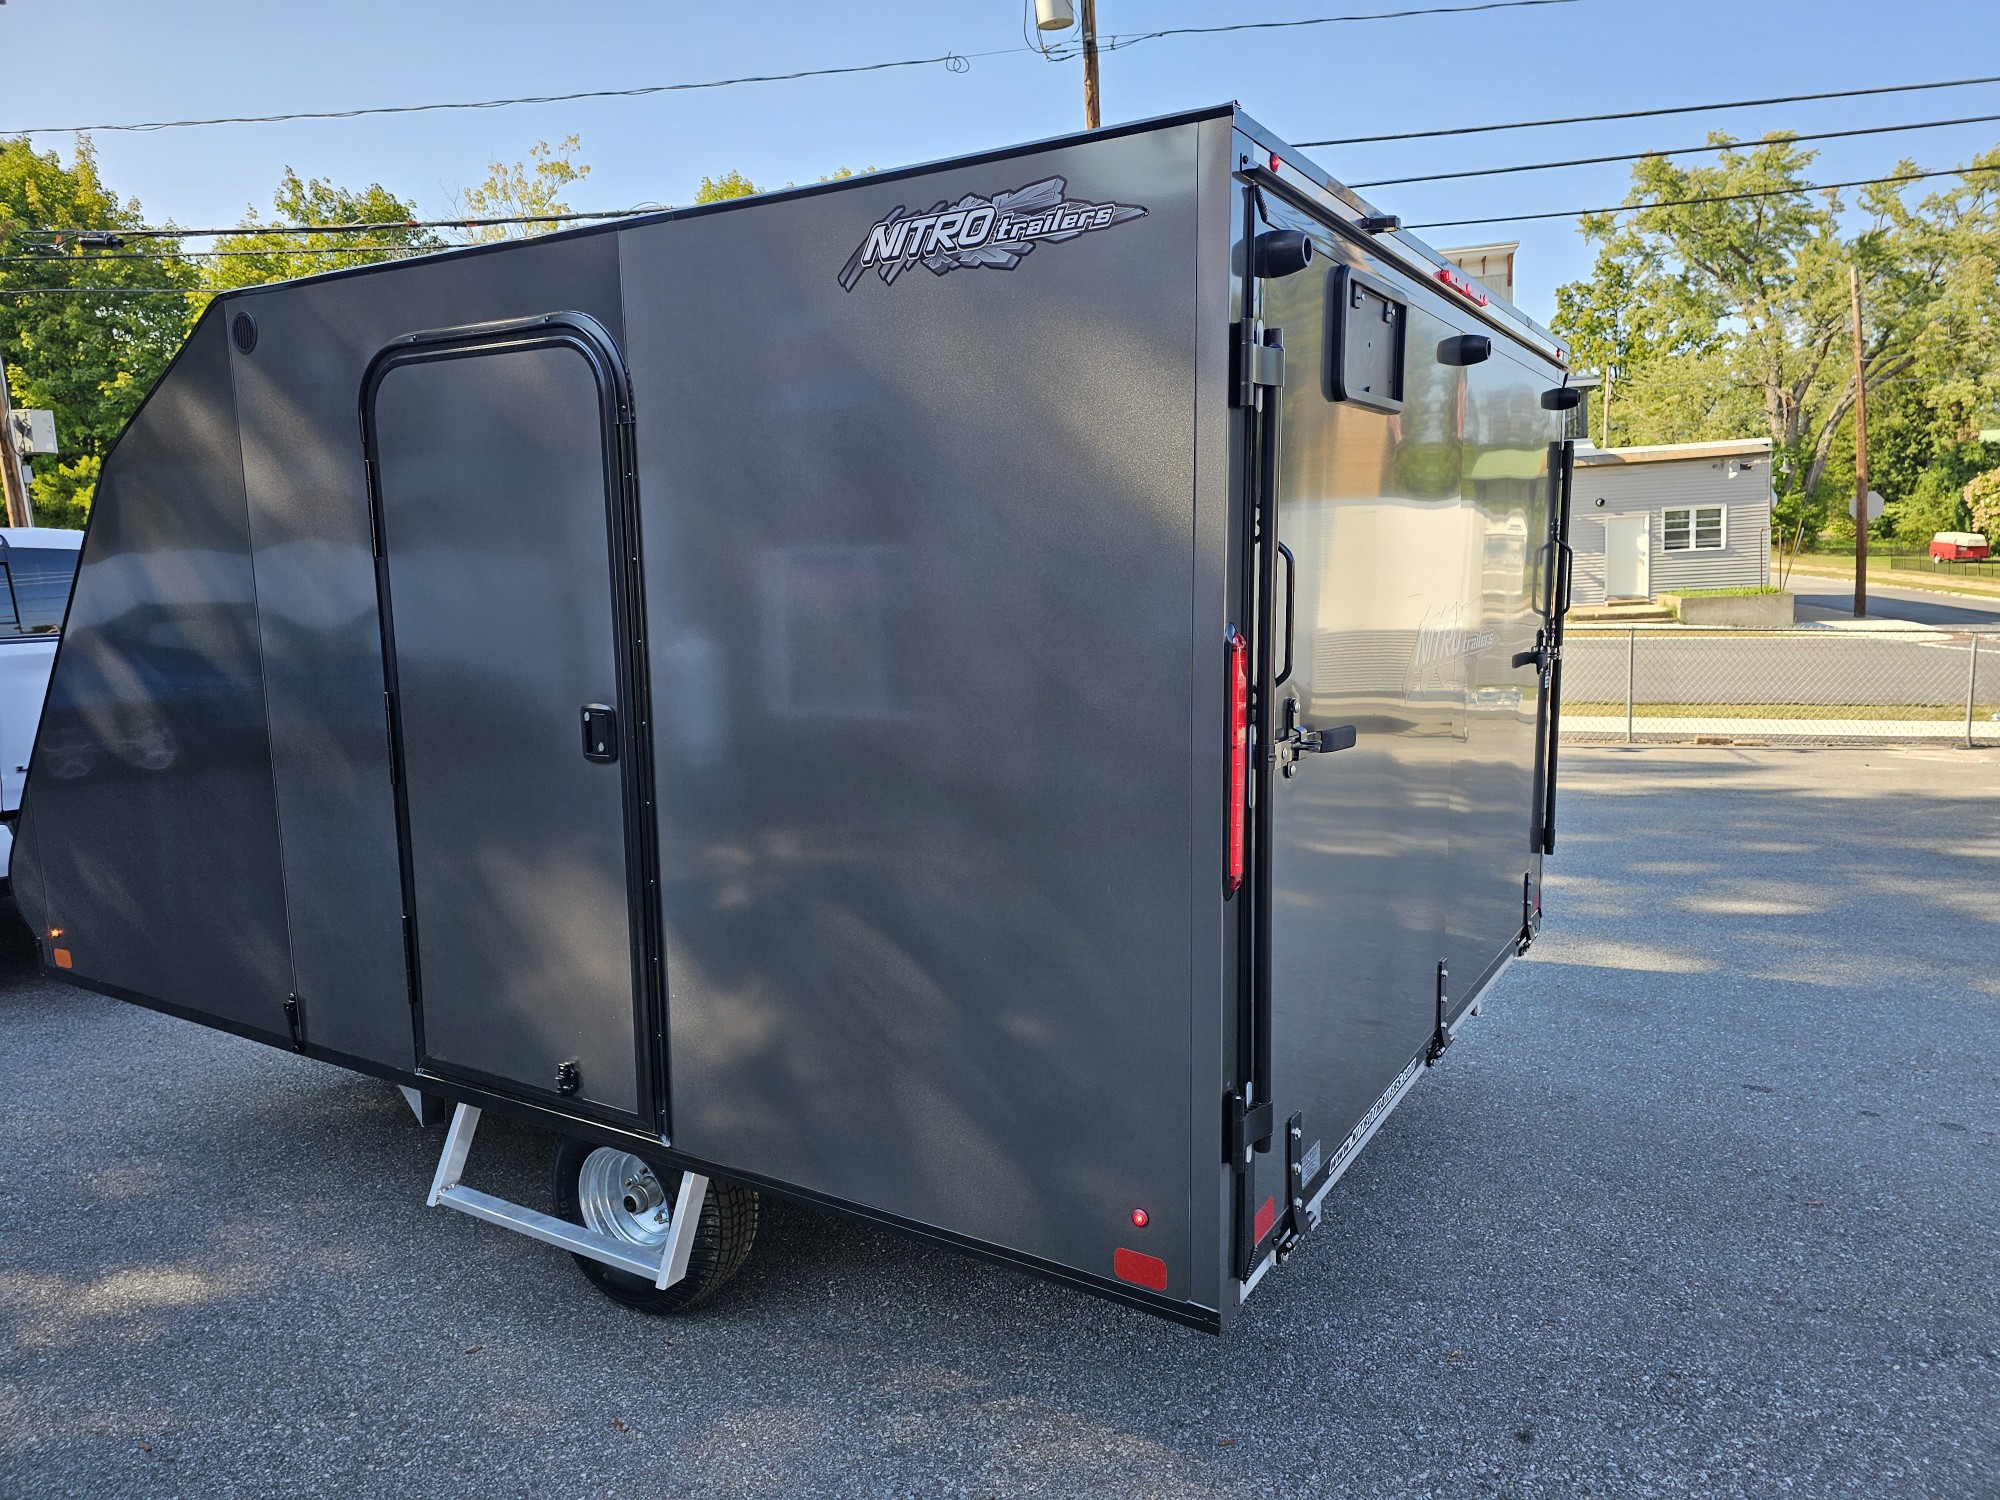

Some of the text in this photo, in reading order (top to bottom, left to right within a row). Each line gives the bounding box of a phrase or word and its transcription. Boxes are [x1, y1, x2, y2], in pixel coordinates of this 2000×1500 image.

[861, 205, 1114, 266] NITRO trailers
[1463, 629, 1494, 652] trailers
